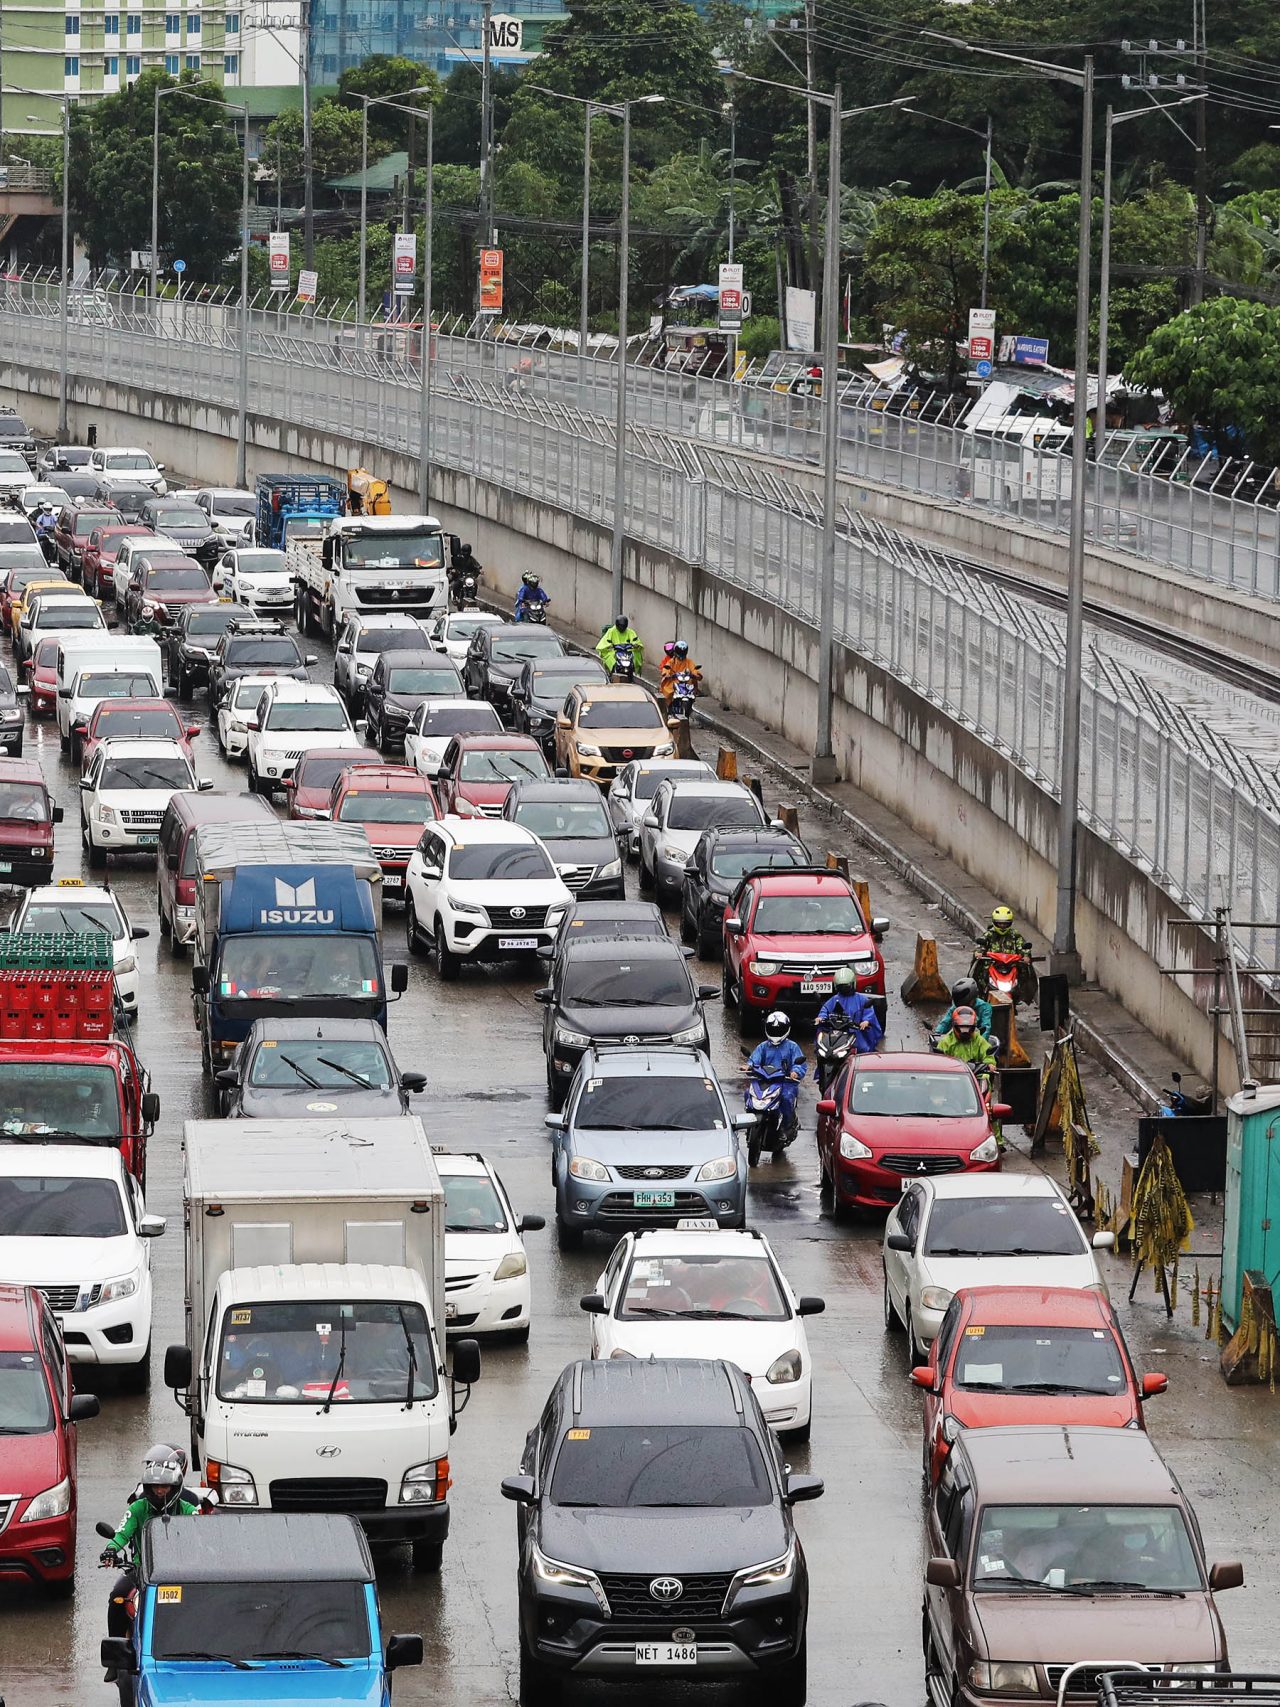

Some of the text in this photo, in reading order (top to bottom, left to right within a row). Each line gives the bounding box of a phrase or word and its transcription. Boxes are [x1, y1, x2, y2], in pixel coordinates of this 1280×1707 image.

[261, 909, 334, 924] ISUZU
[657, 1193, 673, 1203] 353
[637, 1647, 696, 1660] NET 1486
